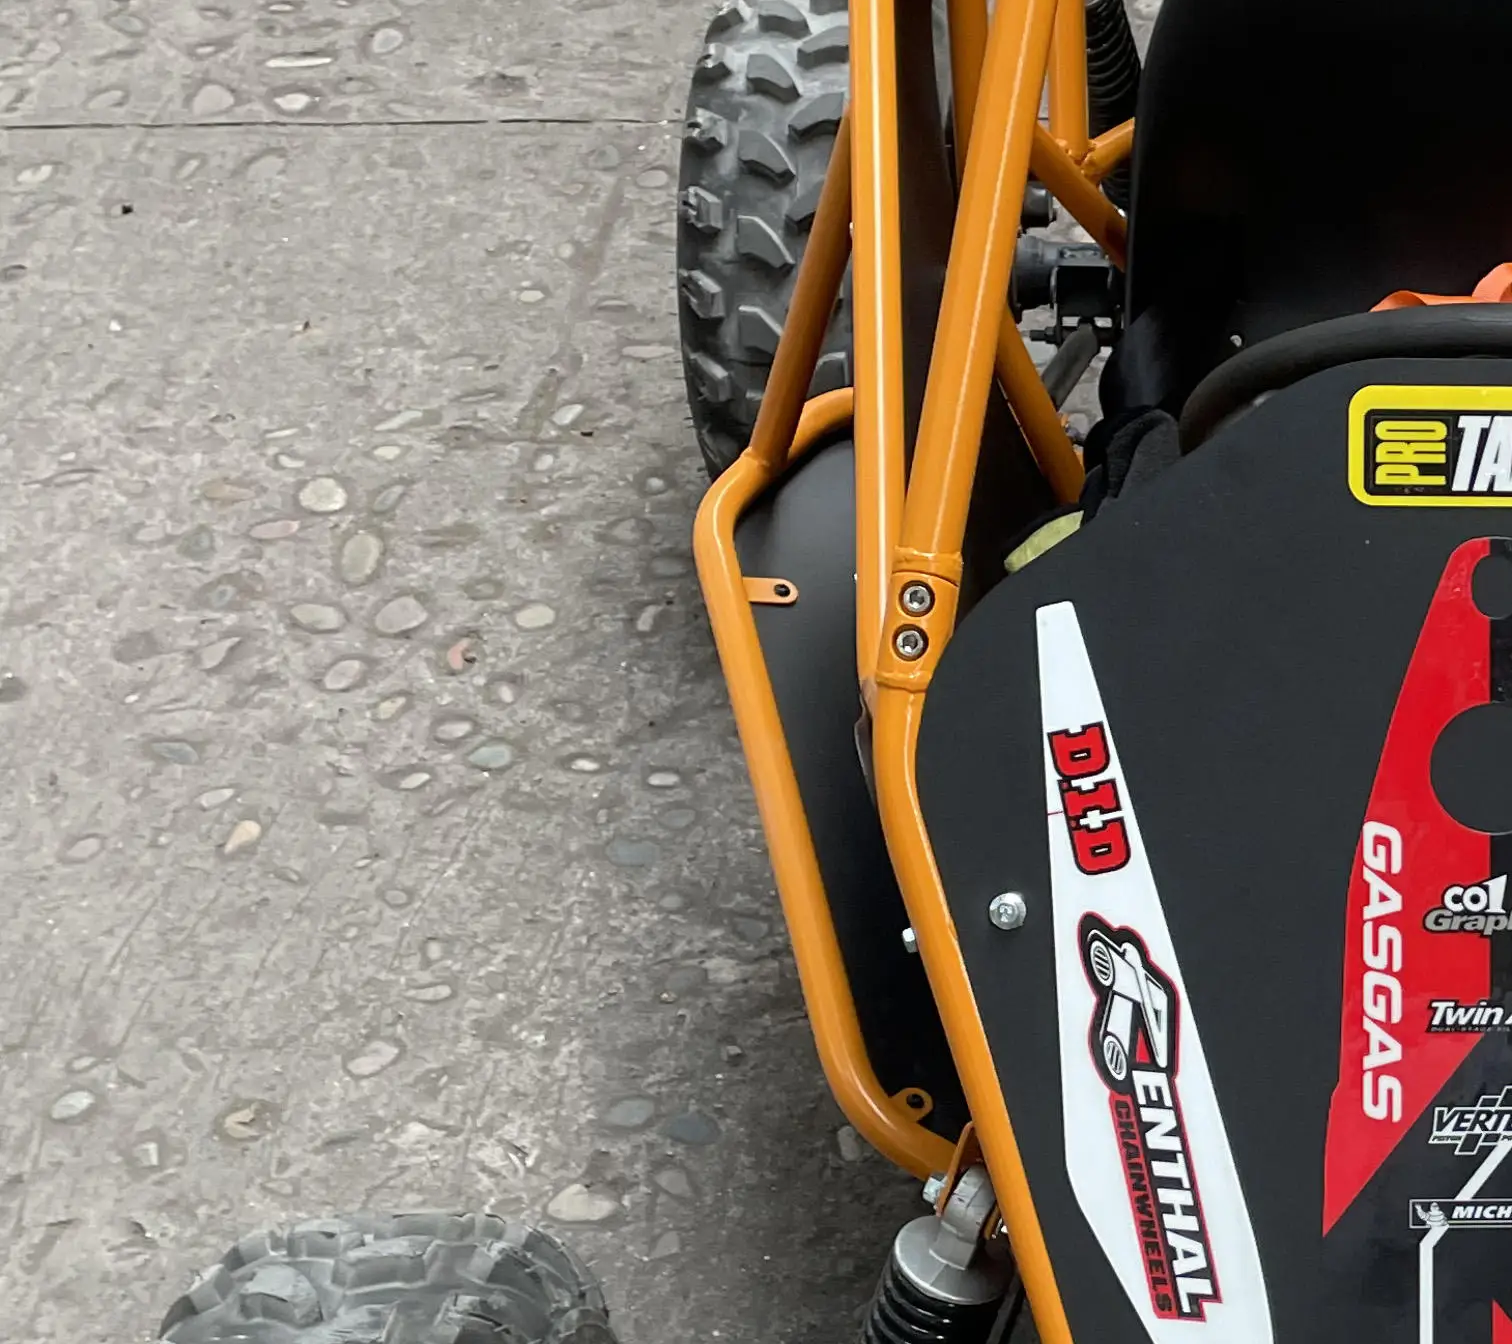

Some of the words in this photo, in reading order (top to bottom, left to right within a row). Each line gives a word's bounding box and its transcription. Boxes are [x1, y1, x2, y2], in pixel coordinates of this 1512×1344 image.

[1374, 420, 1448, 485] PRO
[1362, 821, 1402, 1123] GASGAS
[1431, 1001, 1504, 1025] Twin
[1113, 1099, 1175, 1314] CHAINWHEELS
